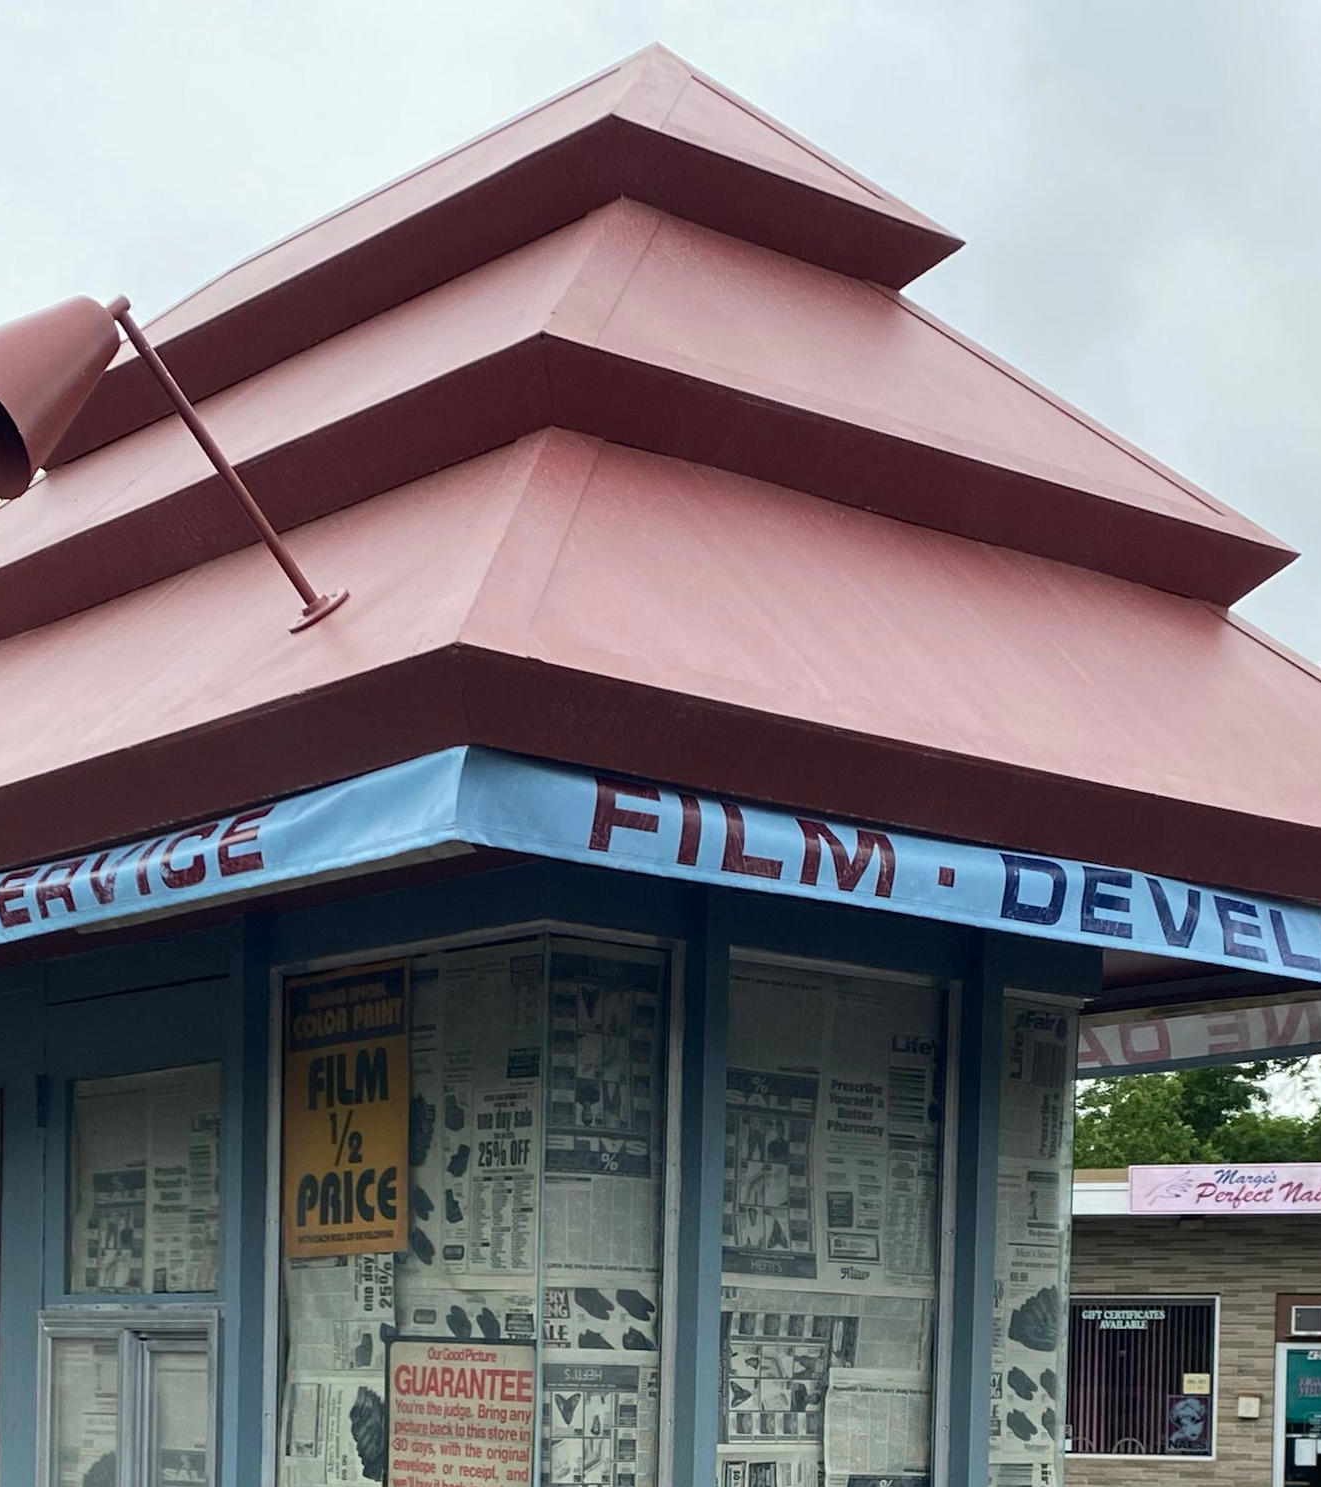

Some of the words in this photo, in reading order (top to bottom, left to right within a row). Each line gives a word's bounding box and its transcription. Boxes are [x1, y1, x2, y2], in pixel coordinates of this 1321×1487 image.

[588, 776, 895, 898] FILM
[293, 1008, 348, 1040] COLOR
[307, 1046, 390, 1111] FILM
[830, 1078, 884, 1095] Prescribe
[836, 1107, 874, 1122] Better
[827, 1119, 885, 1138] Pharmacy
[510, 1139, 531, 1166] OFF
[1214, 1169, 1278, 1189] Marge's
[296, 1165, 398, 1228] PRICE
[1194, 1181, 1275, 1210] Perfect
[1082, 1310, 1104, 1320] GIFT
[1103, 1309, 1167, 1321] CERTIFICATES
[1098, 1319, 1149, 1330] AVAILABLE
[428, 1346, 441, 1361] Our
[443, 1348, 464, 1361] Good
[465, 1349, 497, 1363] Picture
[394, 1363, 534, 1403] GUARANTEE
[395, 1398, 426, 1415] You're
[427, 1400, 443, 1416] the
[443, 1402, 473, 1421] judge.
[478, 1404, 508, 1424] Bring
[509, 1408, 532, 1425] any
[393, 1419, 428, 1434] picture
[429, 1421, 453, 1436] back
[455, 1421, 465, 1436] to
[466, 1422, 486, 1439] this
[488, 1425, 518, 1441] store
[519, 1426, 531, 1442] in
[392, 1437, 408, 1452] 30
[440, 1441, 462, 1457] with
[464, 1443, 483, 1458] the
[486, 1446, 530, 1464] original
[393, 1458, 437, 1475] envelope
[442, 1463, 455, 1476] or
[459, 1464, 500, 1483] receipt,
[506, 1466, 529, 1483] and
